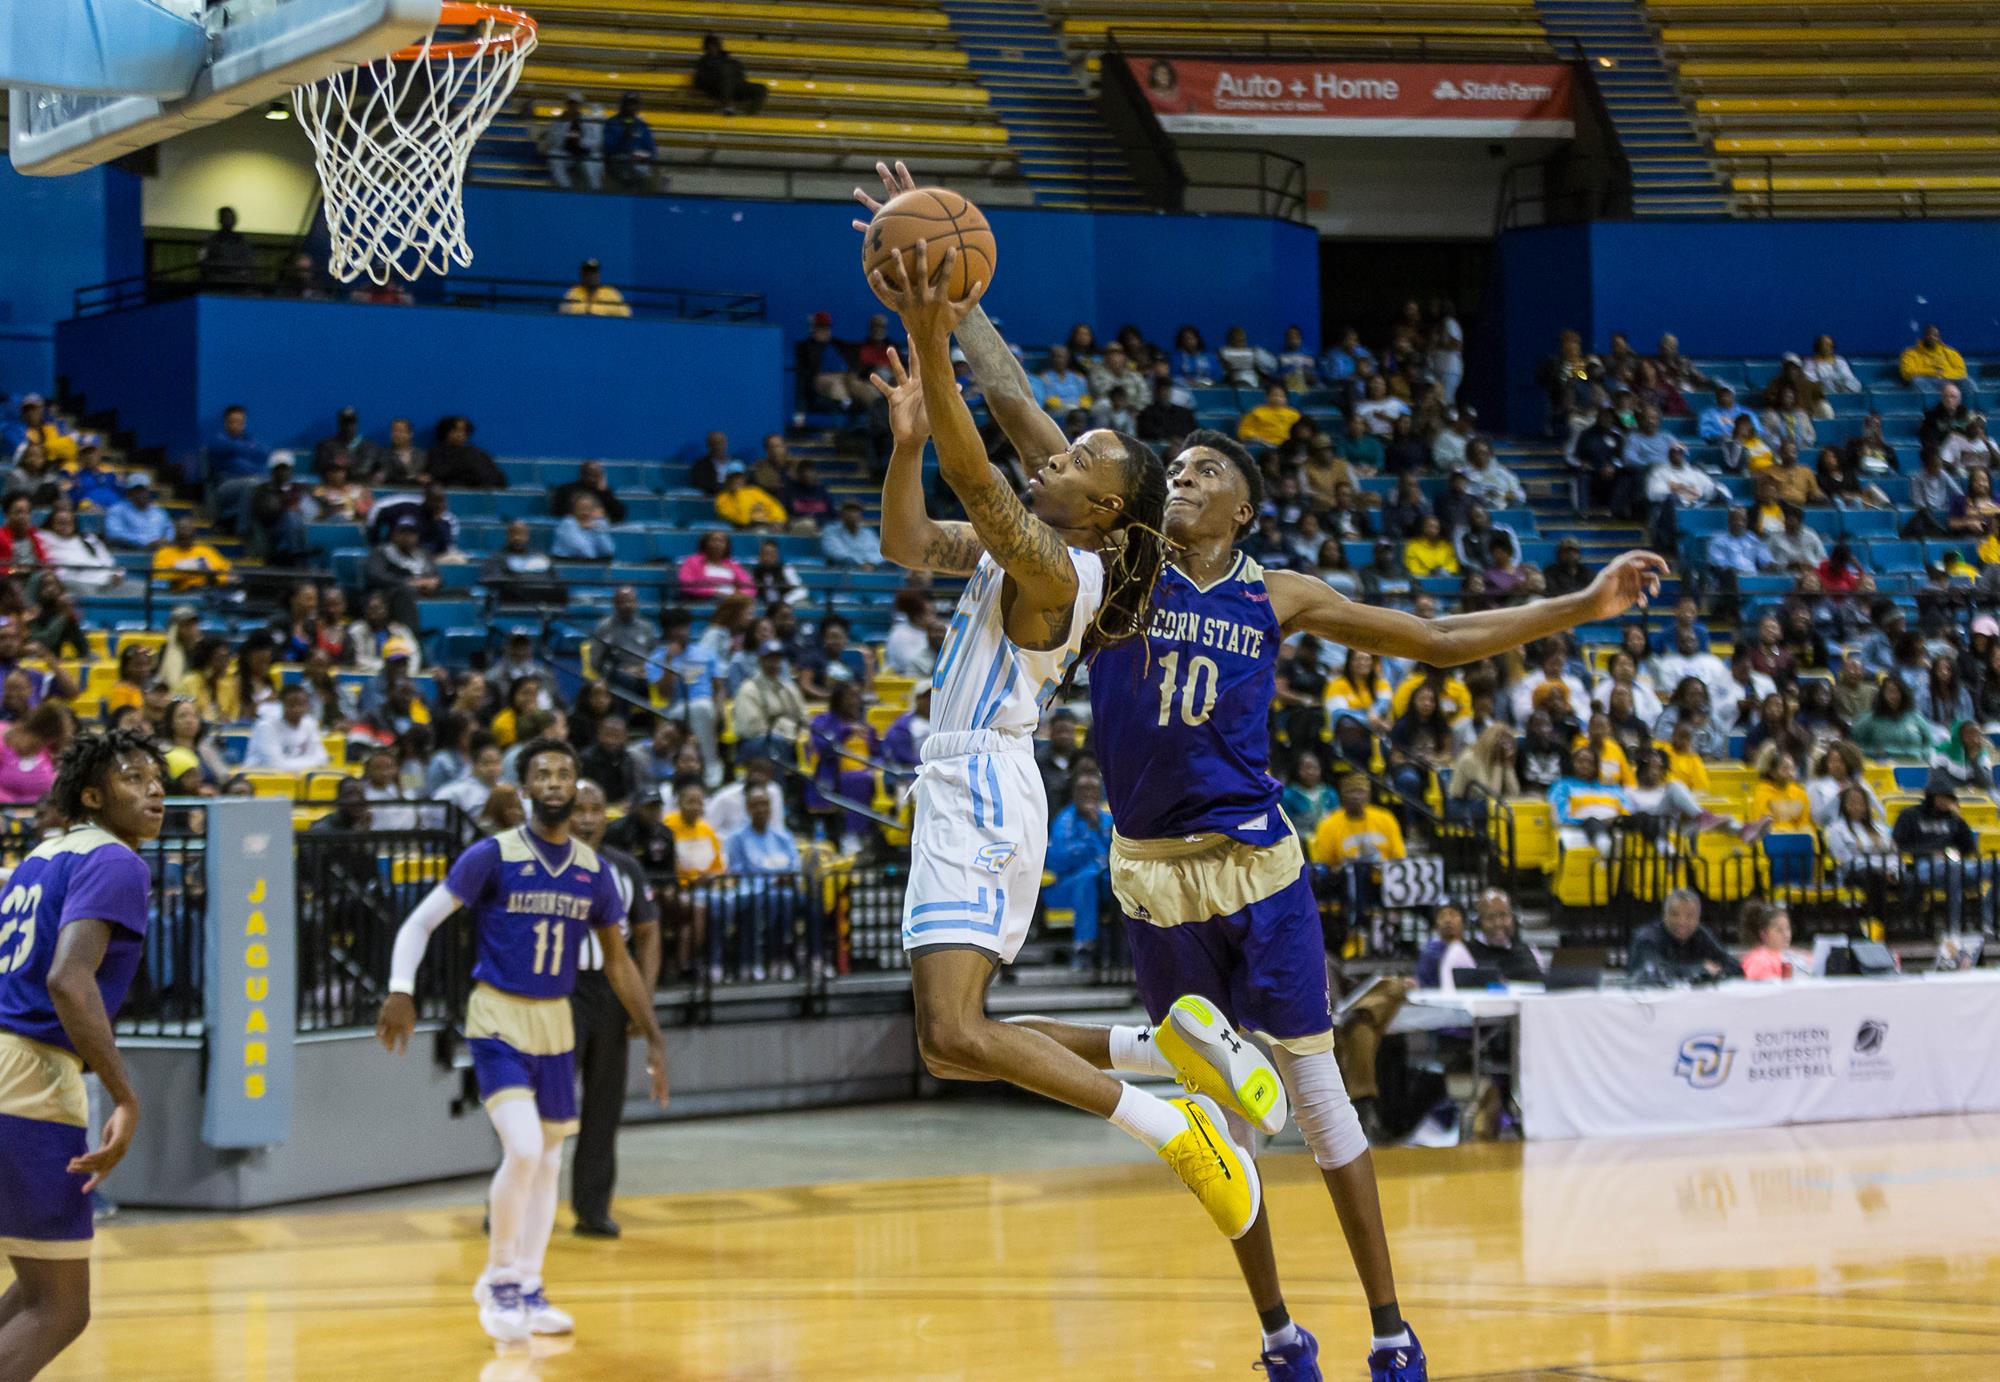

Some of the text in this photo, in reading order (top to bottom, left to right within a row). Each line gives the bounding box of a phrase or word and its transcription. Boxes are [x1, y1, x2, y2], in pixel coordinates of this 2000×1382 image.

[1216, 71, 1282, 98] Auto
[1314, 72, 1400, 100] Home
[1129, 608, 1264, 660] CORN STATE
[1158, 650, 1219, 727] 10
[533, 919, 565, 976] 11
[244, 878, 269, 1099] JAGUARS
[1752, 1046, 1832, 1064] UNIVERSITY
[1755, 1028, 1830, 1046] SOUTHERN
[1748, 1064, 1836, 1081] BASKETBALL
